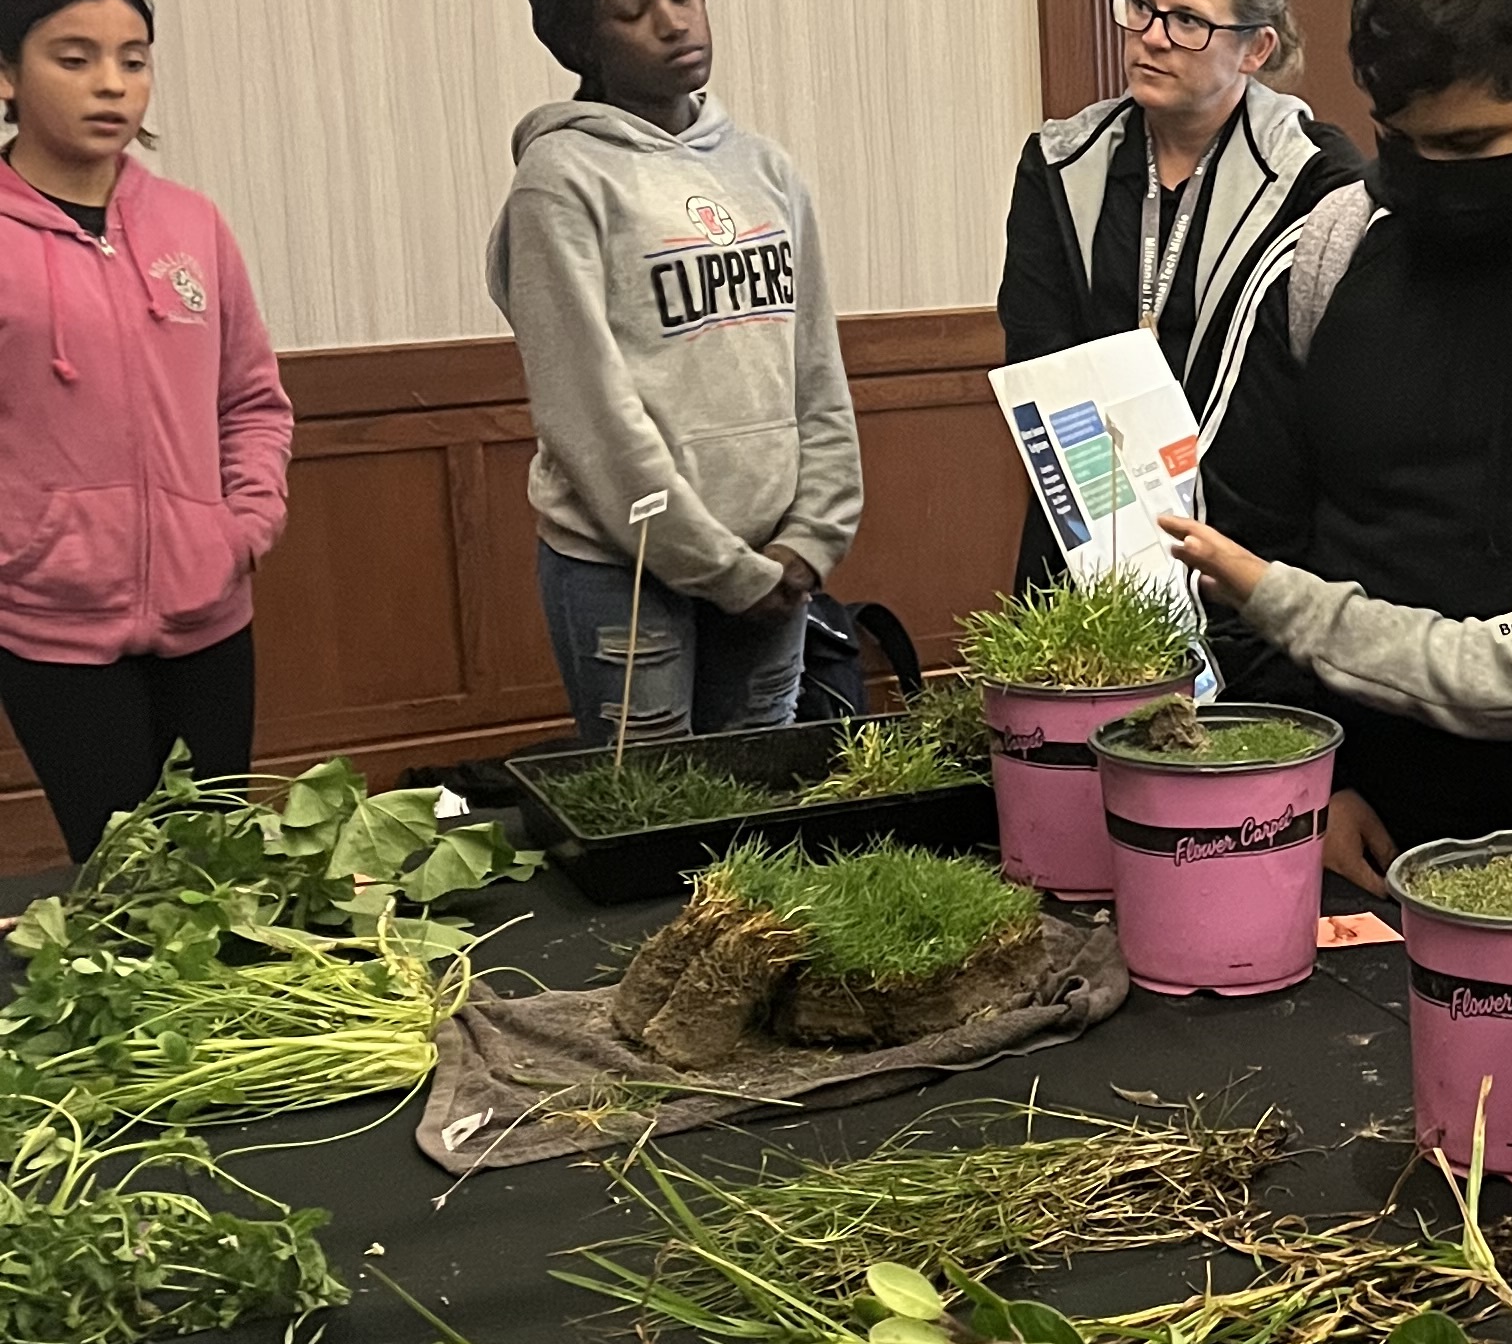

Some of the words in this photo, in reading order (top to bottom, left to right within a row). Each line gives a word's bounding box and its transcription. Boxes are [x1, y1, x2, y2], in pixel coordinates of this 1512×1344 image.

[1168, 214, 1190, 253] Middle
[650, 240, 794, 328] CLIPPERS
[1174, 834, 1237, 867] Flower
[1240, 804, 1294, 847] Carpet
